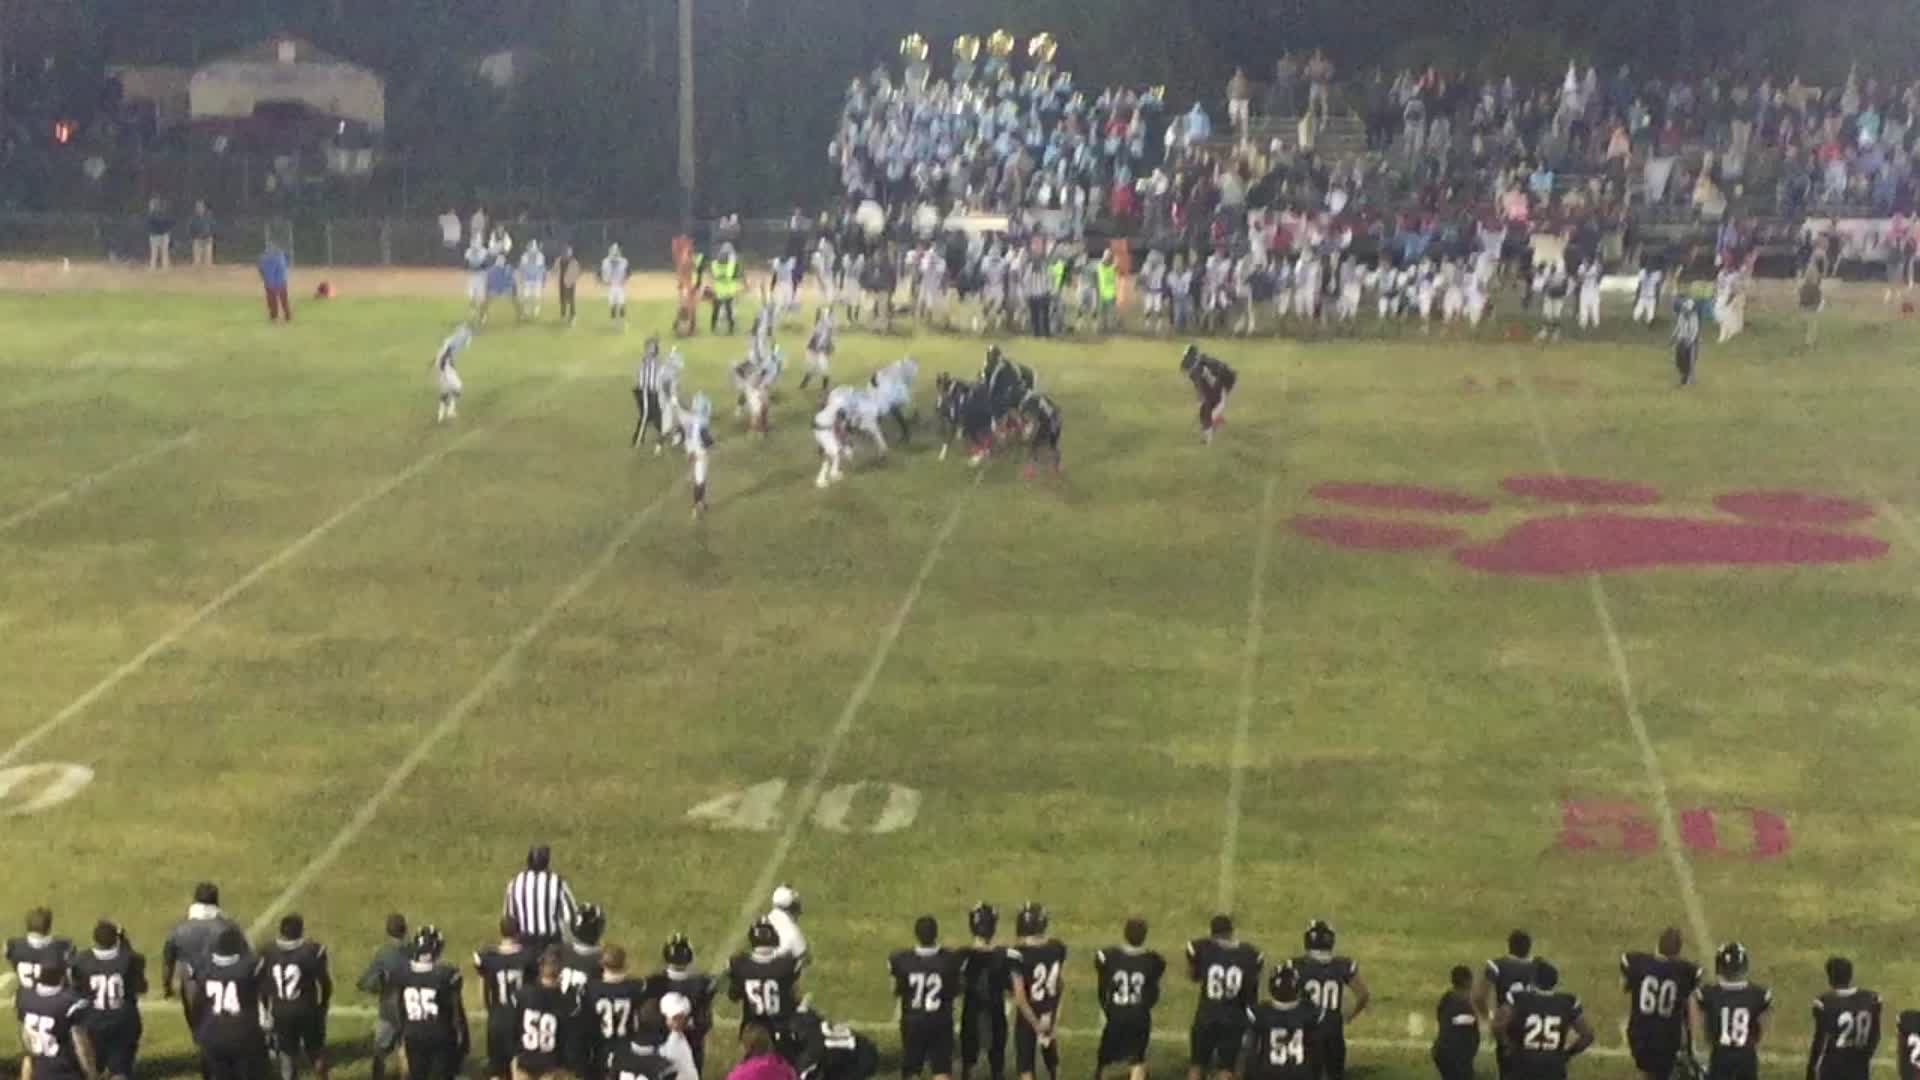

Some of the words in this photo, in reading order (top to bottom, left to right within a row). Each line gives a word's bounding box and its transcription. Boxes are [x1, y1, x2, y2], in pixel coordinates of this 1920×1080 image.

[686, 778, 922, 833] 40
[1560, 798, 1791, 858] 50
[17, 962, 42, 989] 5
[89, 973, 125, 1010] 70
[272, 964, 301, 1000] 12
[909, 973, 944, 1012] 72
[1112, 970, 1146, 1005] 33
[1207, 964, 1243, 1000] 69
[205, 980, 241, 1014] 74
[745, 979, 780, 1015] 56
[1639, 975, 1677, 1017] 60
[522, 1008, 558, 1051] 58
[596, 997, 632, 1038] 37
[1523, 1013, 1562, 1049] 25
[1719, 1007, 1750, 1047] 18
[1269, 1027, 1305, 1065] 54
